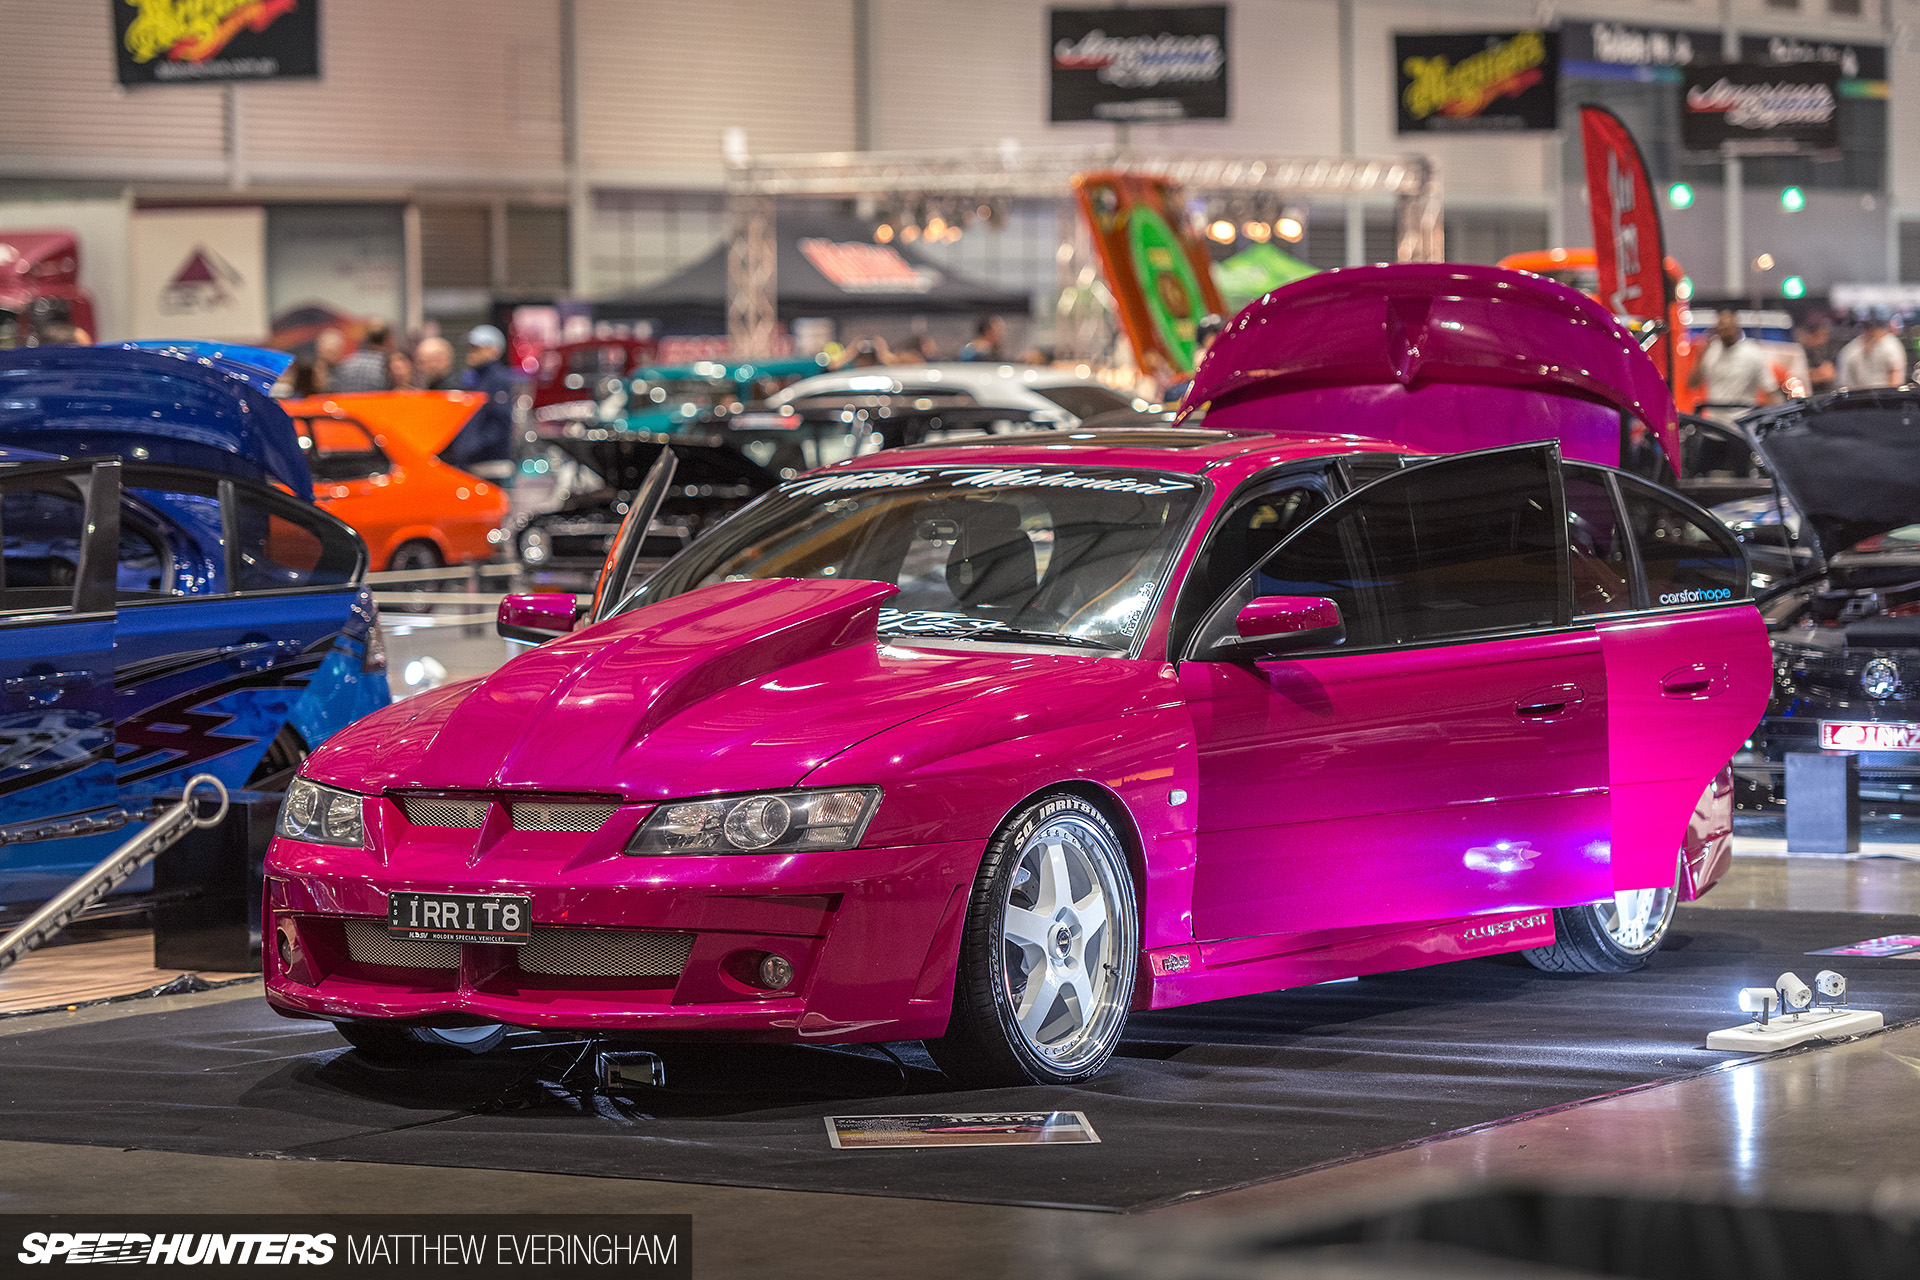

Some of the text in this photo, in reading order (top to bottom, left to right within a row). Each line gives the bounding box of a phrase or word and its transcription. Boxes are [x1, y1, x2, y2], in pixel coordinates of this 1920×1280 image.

[1659, 588, 1731, 604] carsforhope
[410, 900, 520, 931] IRRIT8
[1463, 913, 1548, 941] CLUBSPORT
